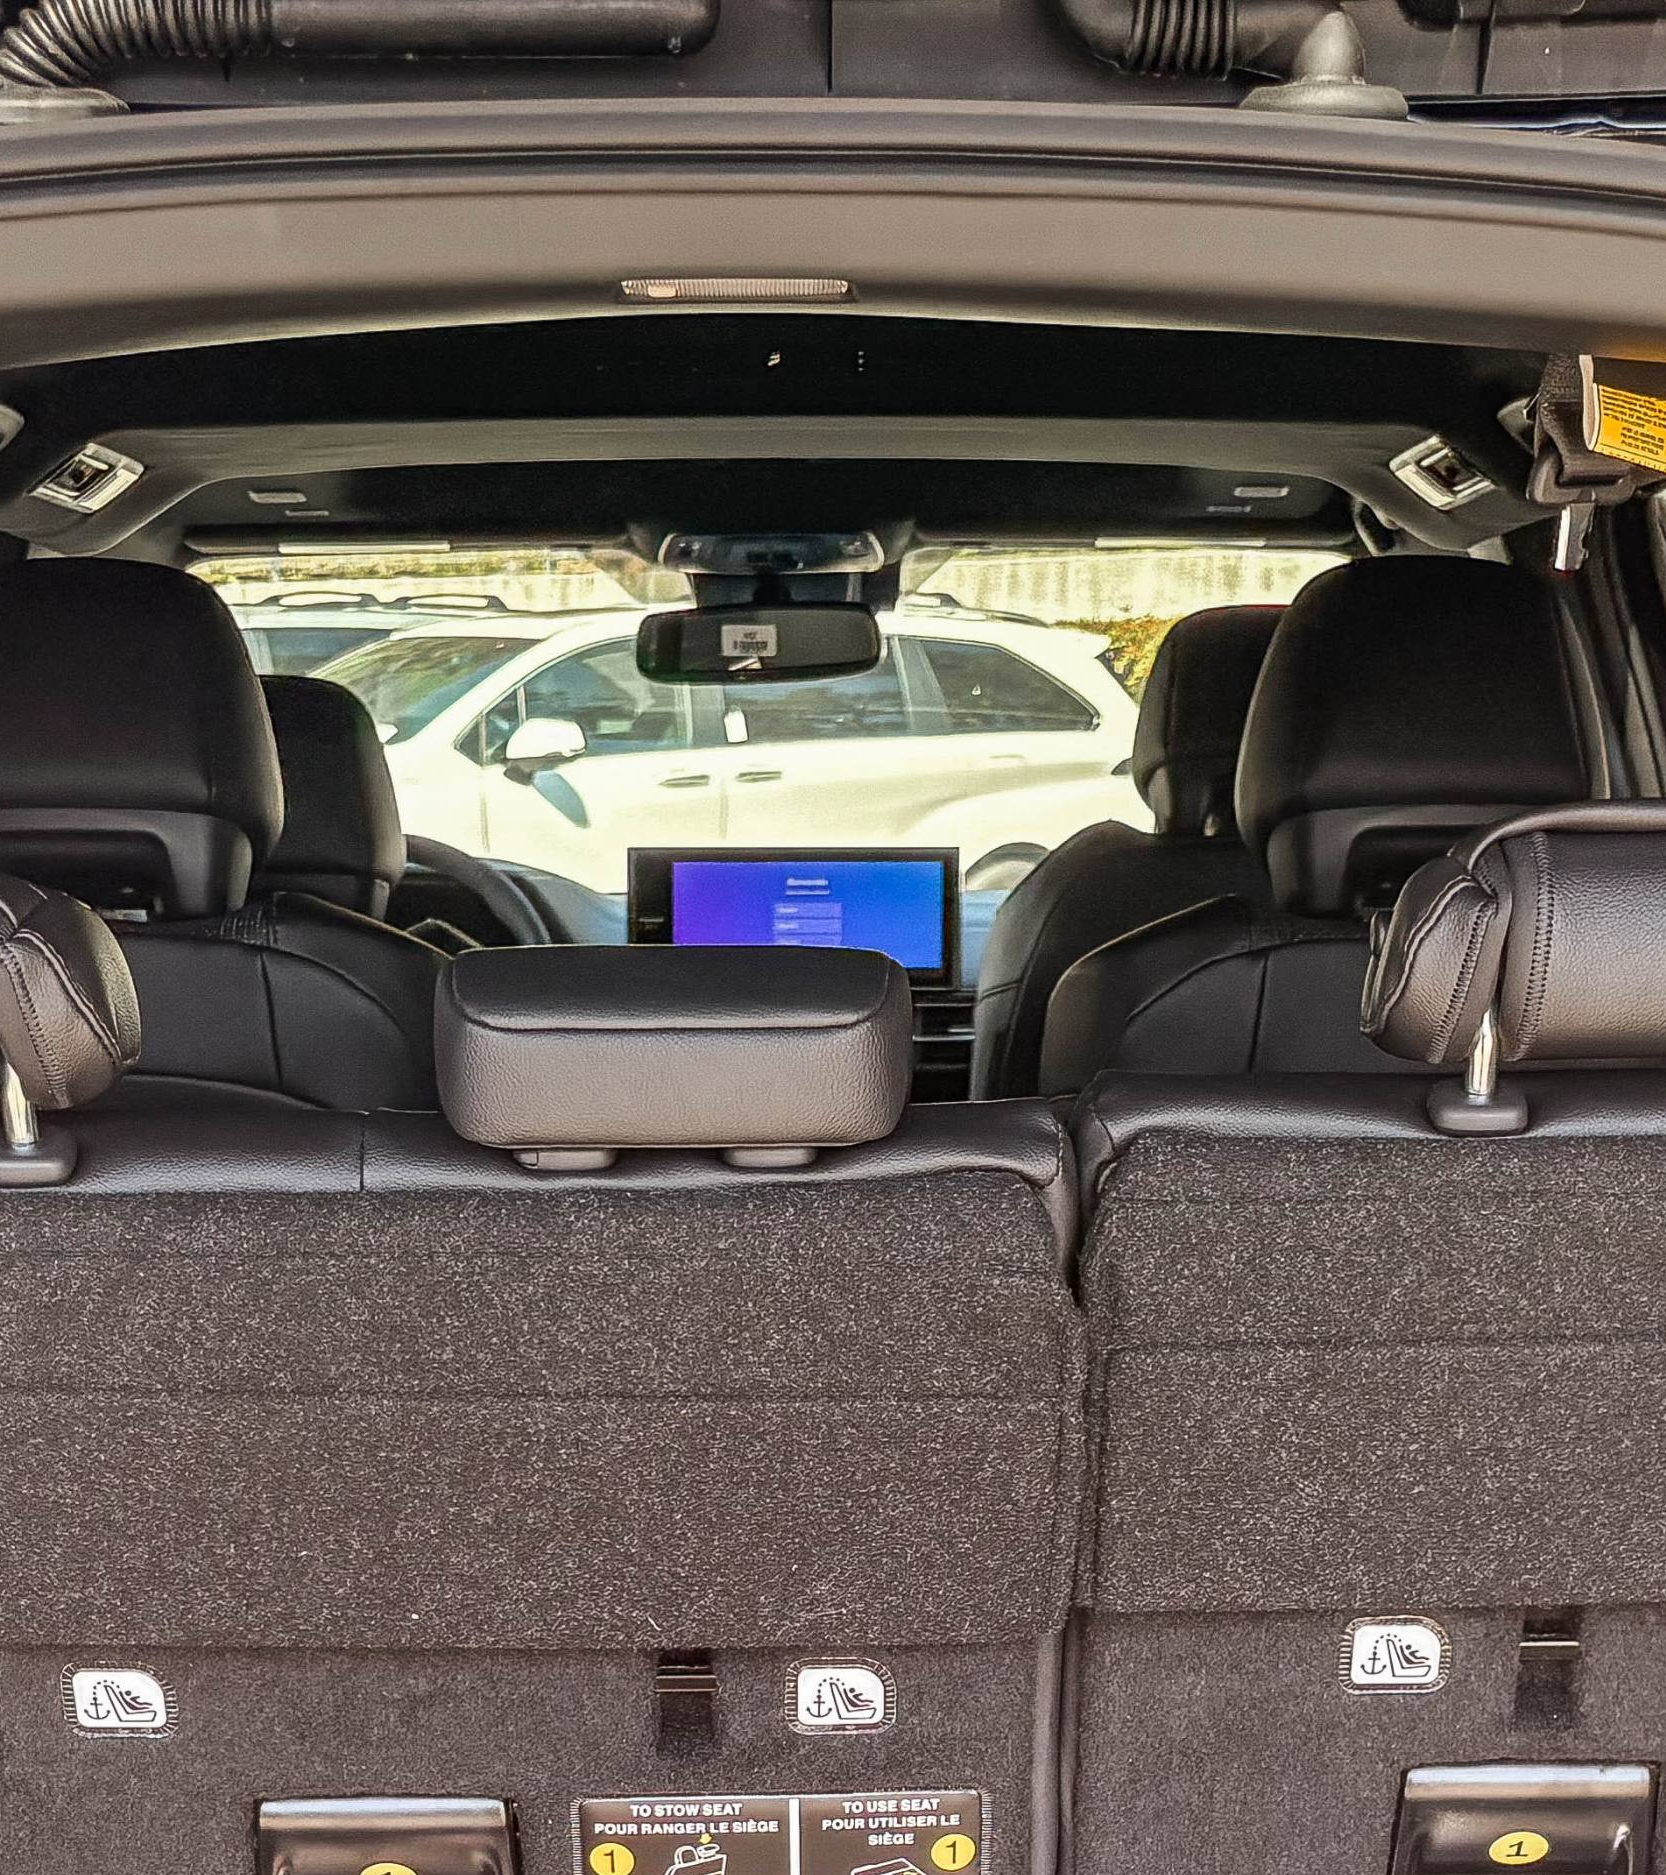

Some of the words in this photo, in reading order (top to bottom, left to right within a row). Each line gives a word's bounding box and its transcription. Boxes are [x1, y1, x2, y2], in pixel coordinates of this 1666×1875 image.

[629, 1804, 653, 1818] TO
[655, 1804, 700, 1817] STOW
[702, 1803, 743, 1816] SEAT
[842, 1801, 863, 1814] TO
[867, 1800, 897, 1813] USE
[900, 1798, 940, 1812] SEAT
[594, 1822, 637, 1835] POUR
[640, 1822, 706, 1835] RANGER
[709, 1821, 729, 1834] LE
[732, 1818, 779, 1833] SIÈGE
[821, 1818, 865, 1831] POUR
[868, 1815, 937, 1829] UTILISER
[940, 1814, 961, 1827] LE
[867, 1831, 915, 1846] SIÈGE
[945, 1840, 957, 1864] 1
[1506, 1840, 1528, 1858] 1
[603, 1849, 616, 1874] 1
